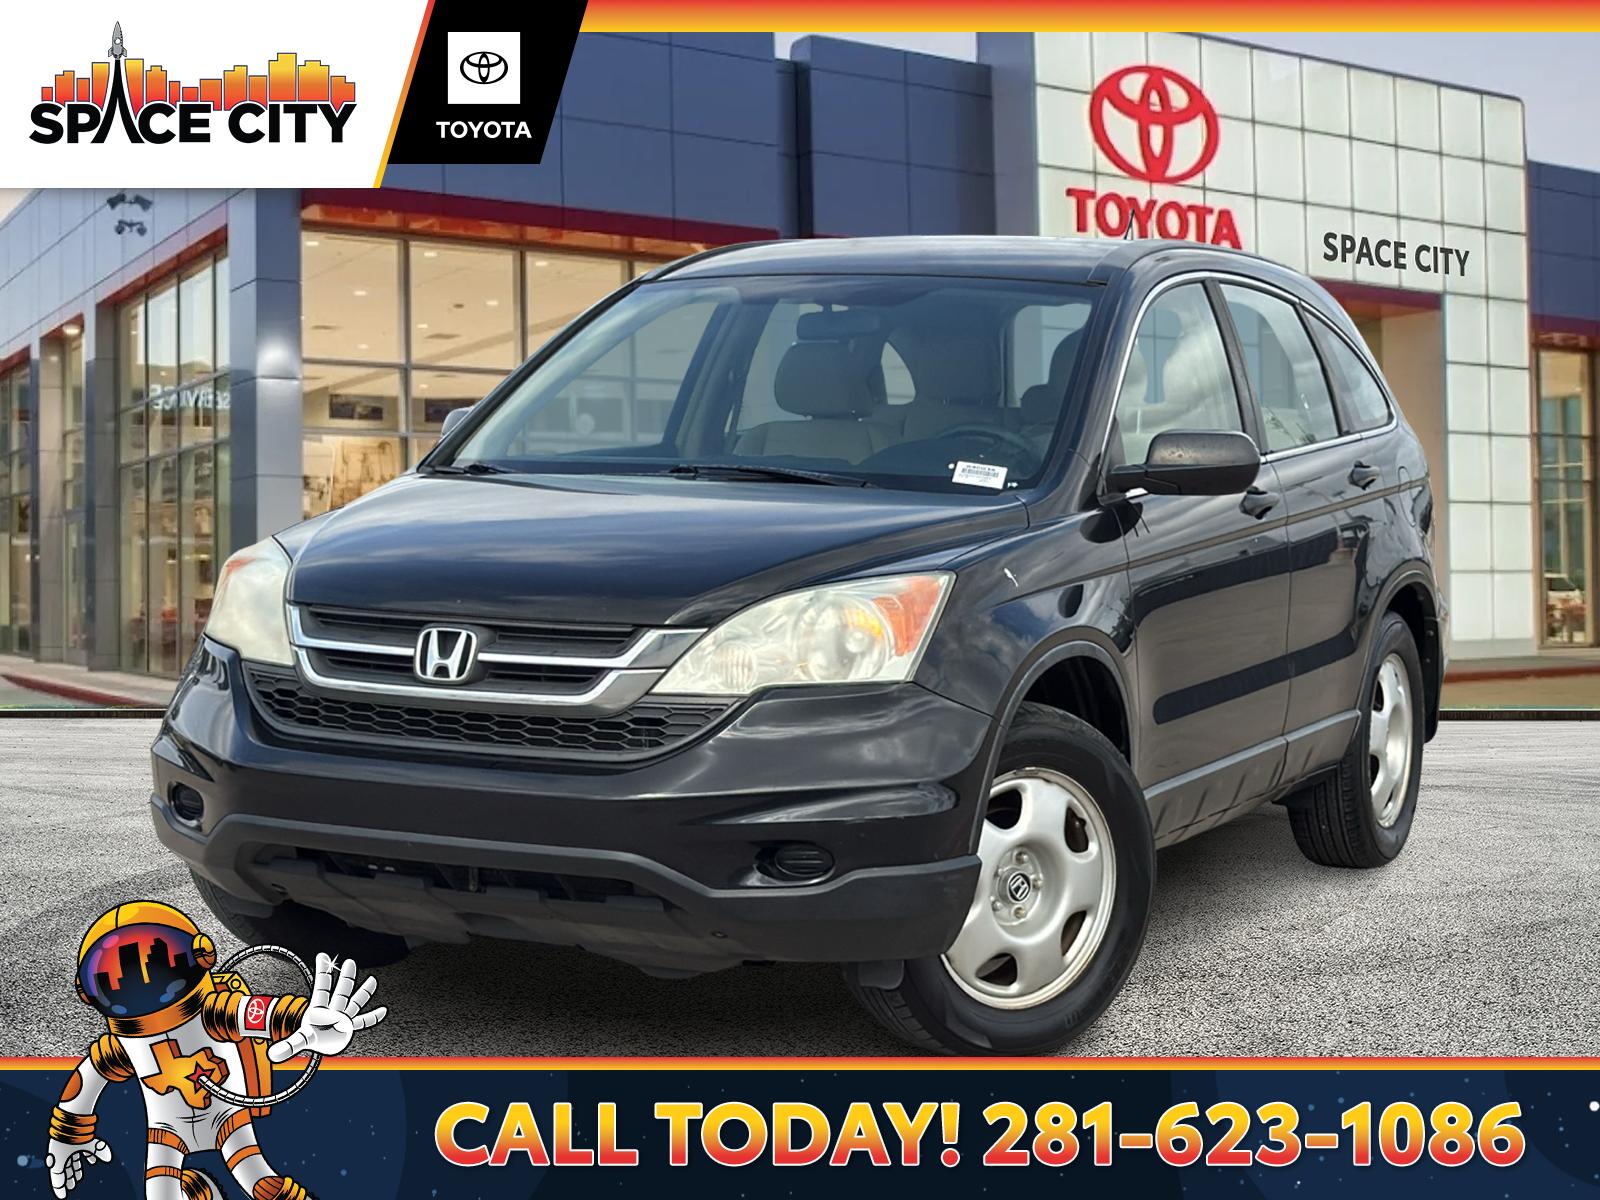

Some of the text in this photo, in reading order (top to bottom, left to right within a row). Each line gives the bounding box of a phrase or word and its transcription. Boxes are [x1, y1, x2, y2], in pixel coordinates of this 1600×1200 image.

[1066, 188, 1242, 250] TOYOTA
[1323, 232, 1470, 277] SPACE CITY
